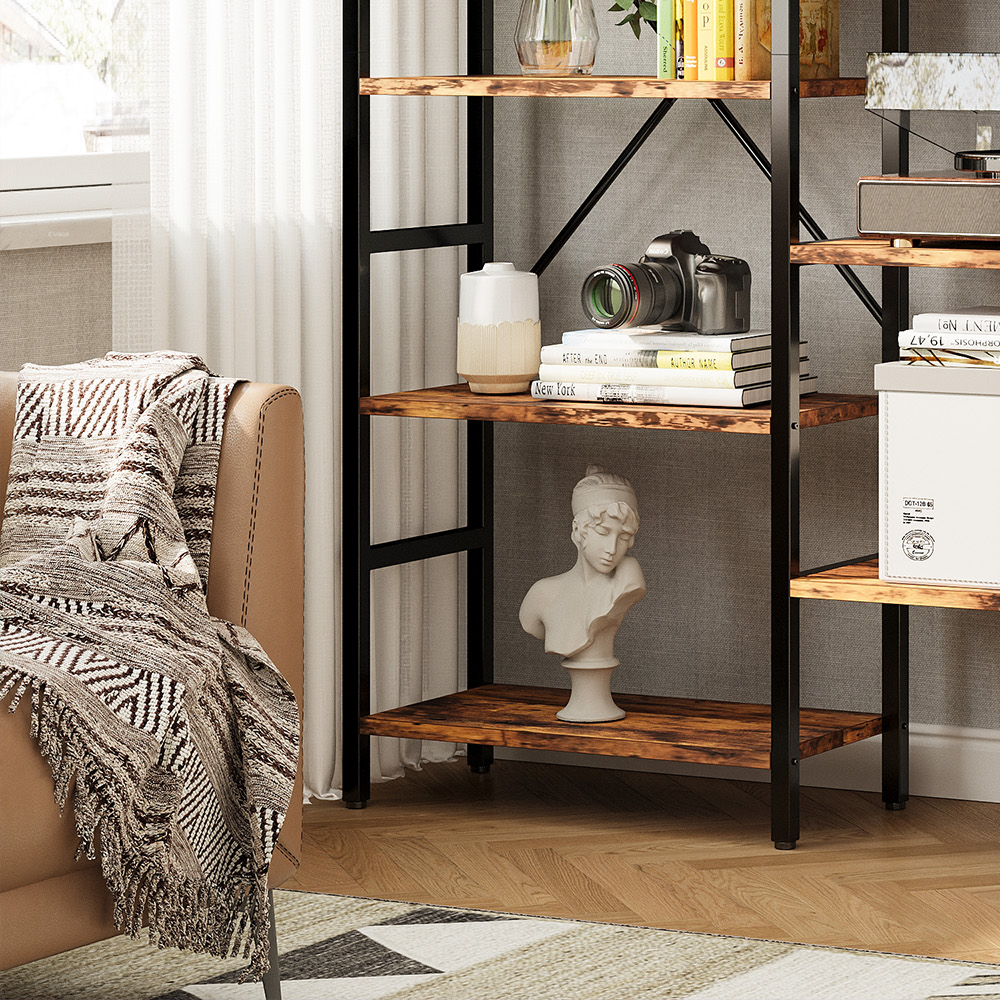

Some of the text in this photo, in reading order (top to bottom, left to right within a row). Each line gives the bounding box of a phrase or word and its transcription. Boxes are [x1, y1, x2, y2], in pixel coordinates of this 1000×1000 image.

[910, 335, 944, 346] 19,47
[562, 353, 582, 364] AFTER
[594, 354, 608, 365] END
[671, 357, 695, 369] AUTHOR
[698, 358, 718, 369] NAME
[535, 382, 576, 397] New York
